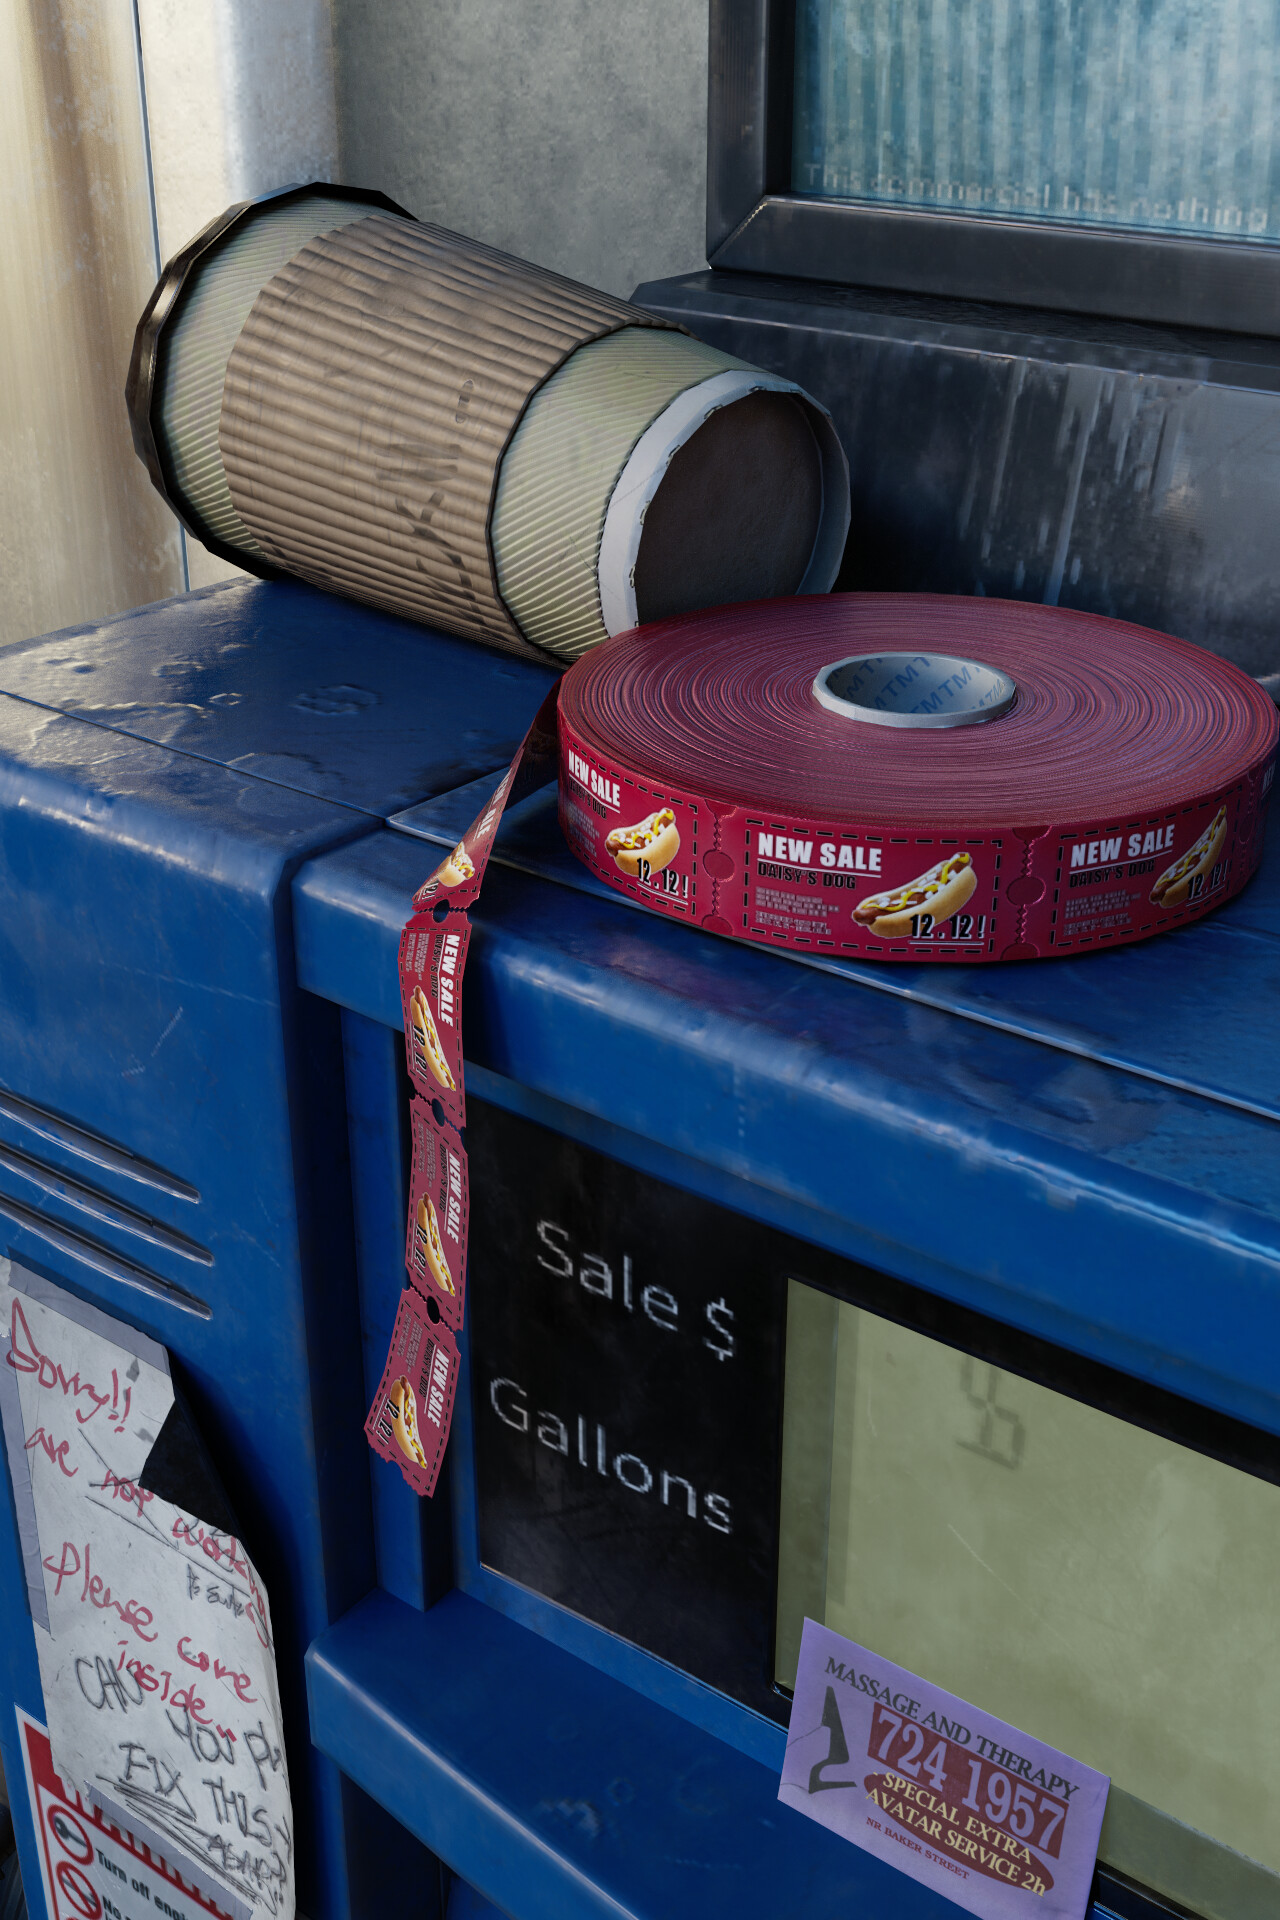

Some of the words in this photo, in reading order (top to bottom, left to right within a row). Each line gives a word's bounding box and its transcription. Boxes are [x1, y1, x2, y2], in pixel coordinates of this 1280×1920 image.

[568, 749, 589, 786] NEW
[591, 769, 621, 808] SALE
[592, 797, 607, 819] DOG
[758, 832, 814, 864] NEW
[820, 843, 882, 871] SALE
[1070, 836, 1123, 868] NEW
[1127, 823, 1175, 858] SALE
[757, 862, 818, 886] DAISY'S
[823, 872, 857, 890] DOG
[1069, 865, 1123, 888] DAISY'S
[1128, 858, 1155, 880] DOG
[441, 934, 461, 976] NEW
[440, 978, 454, 1028] SALE
[448, 1152, 462, 1197] NEW
[447, 1196, 461, 1245] SALE
[536, 1219, 680, 1332] Sale
[704, 1297, 735, 1362] $
[432, 1348, 450, 1391] NEW
[427, 1385, 445, 1429] SALE
[490, 1377, 732, 1535] Gallons
[43, 1542, 159, 1643] Please
[176, 1636, 258, 1704] come
[75, 1655, 145, 1714] CAN
[165, 1704, 236, 1766] YOU
[824, 1656, 922, 1719] MASSAGE
[921, 1709, 972, 1745] AND
[976, 1734, 1081, 1802] THERAPY
[876, 1707, 949, 1792] 724
[961, 1758, 1066, 1851] 1957
[865, 1787, 941, 1838] AVATAR
[944, 1830, 1021, 1883] SERVICE
[1020, 1869, 1048, 1897] 2h
[882, 1771, 960, 1825] SPECIAL
[964, 1816, 1032, 1866] EXTRA
[866, 1816, 882, 1832] NR
[884, 1825, 922, 1855] BAKER
[924, 1848, 970, 1880] STREET
[95, 1848, 128, 1884] Turn
[131, 1878, 150, 1901] off
[102, 1894, 122, 1919] No
